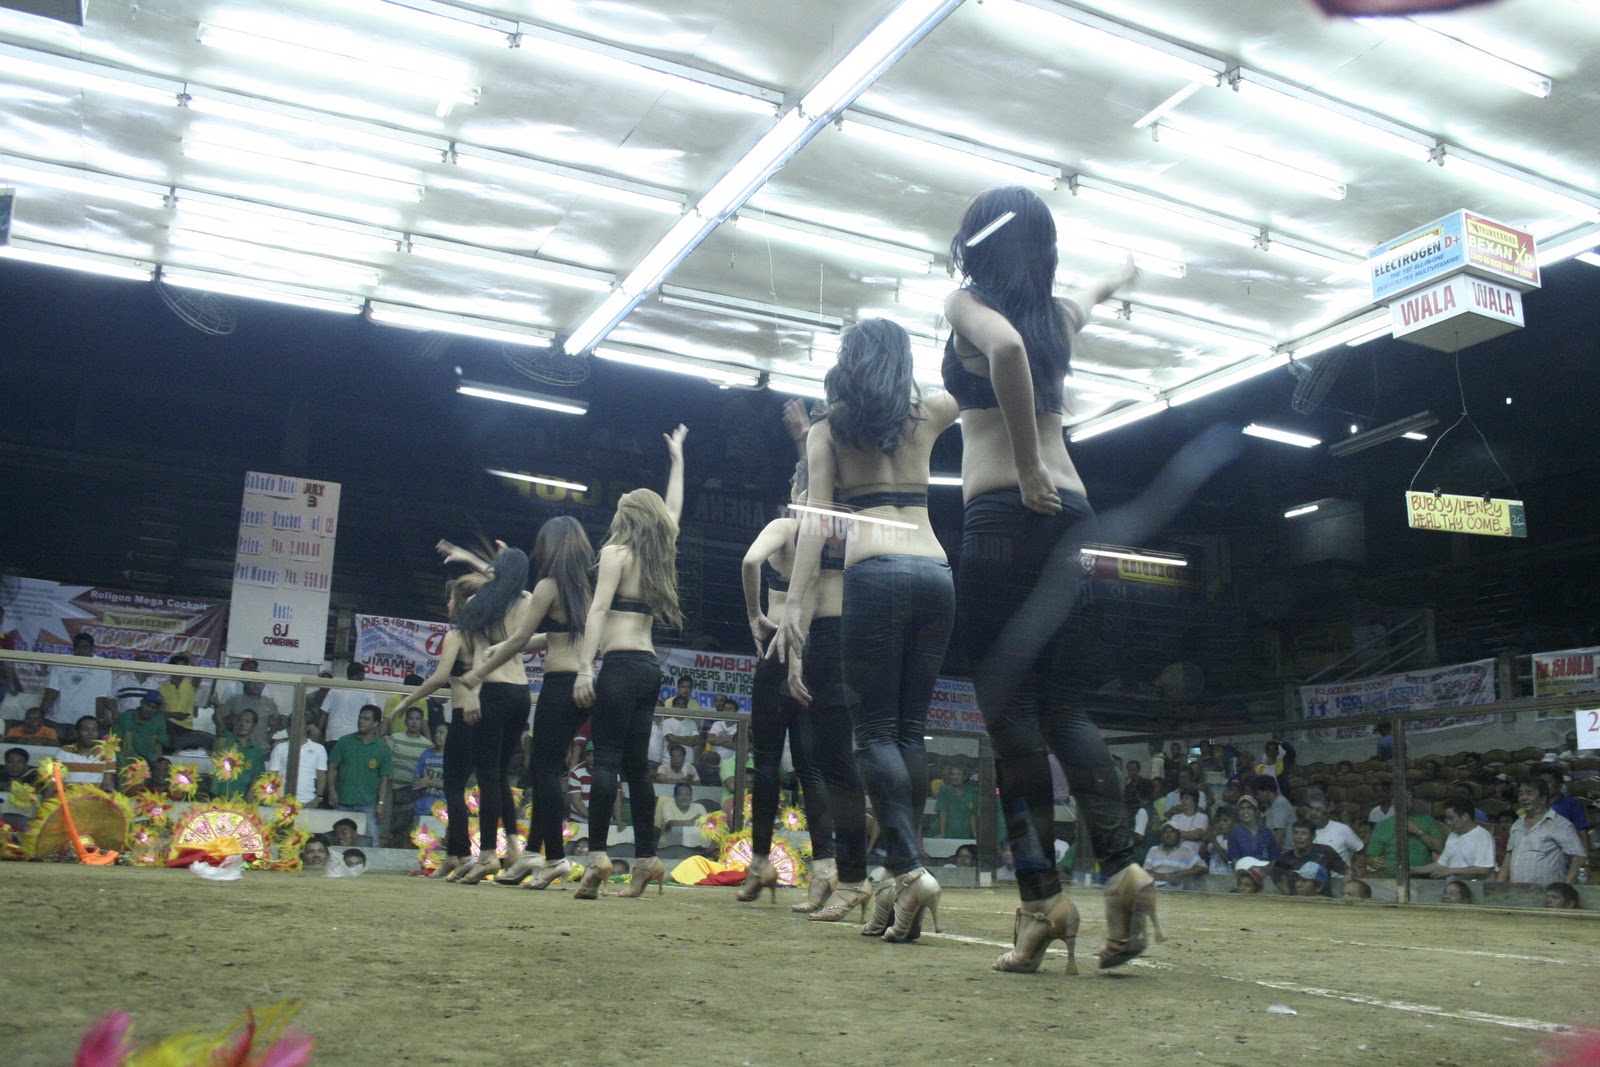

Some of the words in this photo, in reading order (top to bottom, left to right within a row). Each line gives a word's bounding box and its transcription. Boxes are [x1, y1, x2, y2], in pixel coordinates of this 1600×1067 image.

[1374, 240, 1442, 278] ELECTROGEN
[1444, 235, 1461, 249] D+
[1468, 234, 1513, 261] BEXAN
[1514, 243, 1533, 266] XP
[1400, 284, 1457, 327] WALA
[1472, 281, 1516, 317] WALA
[303, 482, 326, 496] JULY
[307, 496, 318, 508] 3
[1411, 495, 1503, 518] BUBOY/HENRY
[1413, 513, 1463, 530] HEALTHY
[90, 590, 132, 602] Roligon
[134, 595, 164, 606] Mega
[166, 599, 209, 611] Cockpit
[429, 623, 449, 633] ROL
[263, 636, 300, 648] COMBINE
[361, 656, 416, 669] JIMMY
[694, 654, 757, 672] MABUH
[713, 681, 736, 694] NEW
[740, 685, 753, 695] RO
